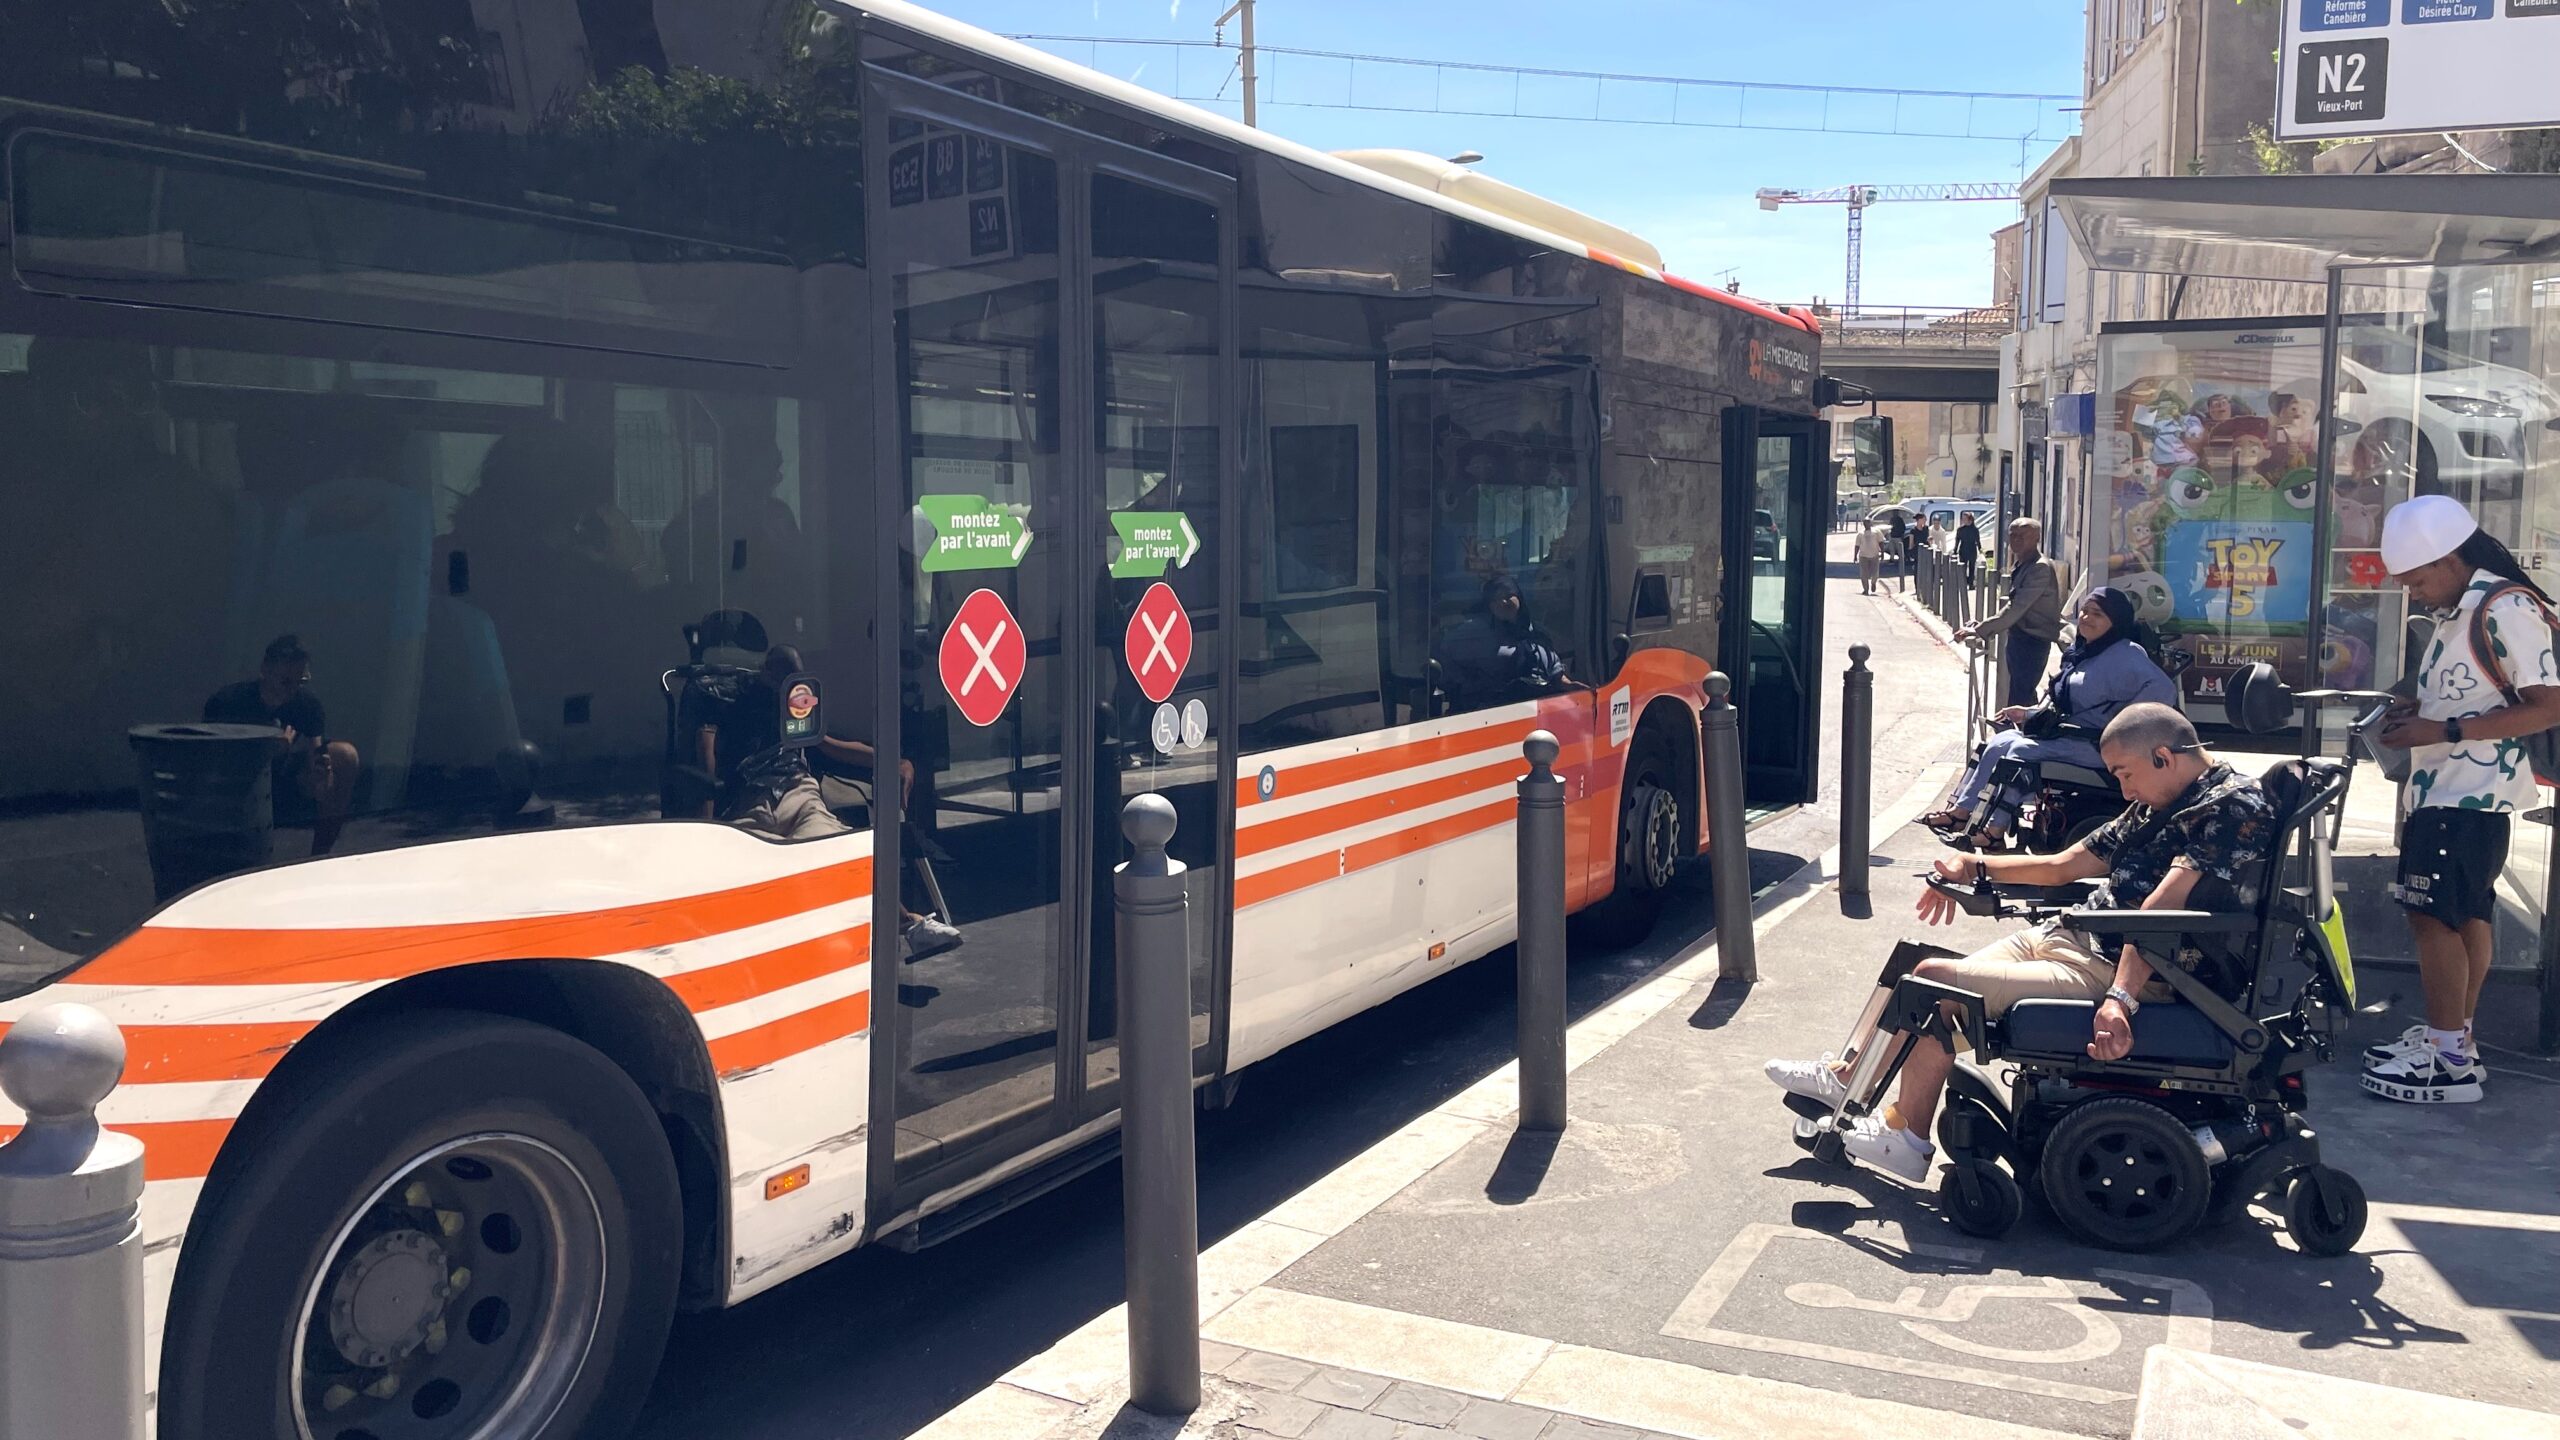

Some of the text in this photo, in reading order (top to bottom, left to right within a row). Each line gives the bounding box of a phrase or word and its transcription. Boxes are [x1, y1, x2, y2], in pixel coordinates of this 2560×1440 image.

[2419, 4, 2477, 18] Désirée Clary
[2324, 12, 2367, 25] Canebière
[2317, 53, 2366, 94] N2
[2317, 100, 2363, 113] Vieux-Port
[951, 512, 1000, 528] montez
[1134, 526, 1172, 540] montez
[940, 531, 1011, 553] par l'avant
[1126, 543, 1180, 562] par l'avant
[2206, 537, 2285, 571] TOY
[2212, 570, 2272, 582] STORY
[2227, 584, 2256, 617] 5
[2200, 644, 2216, 655] LE
[2242, 645, 2278, 657] JUIN
[2209, 656, 2225, 665] AU
